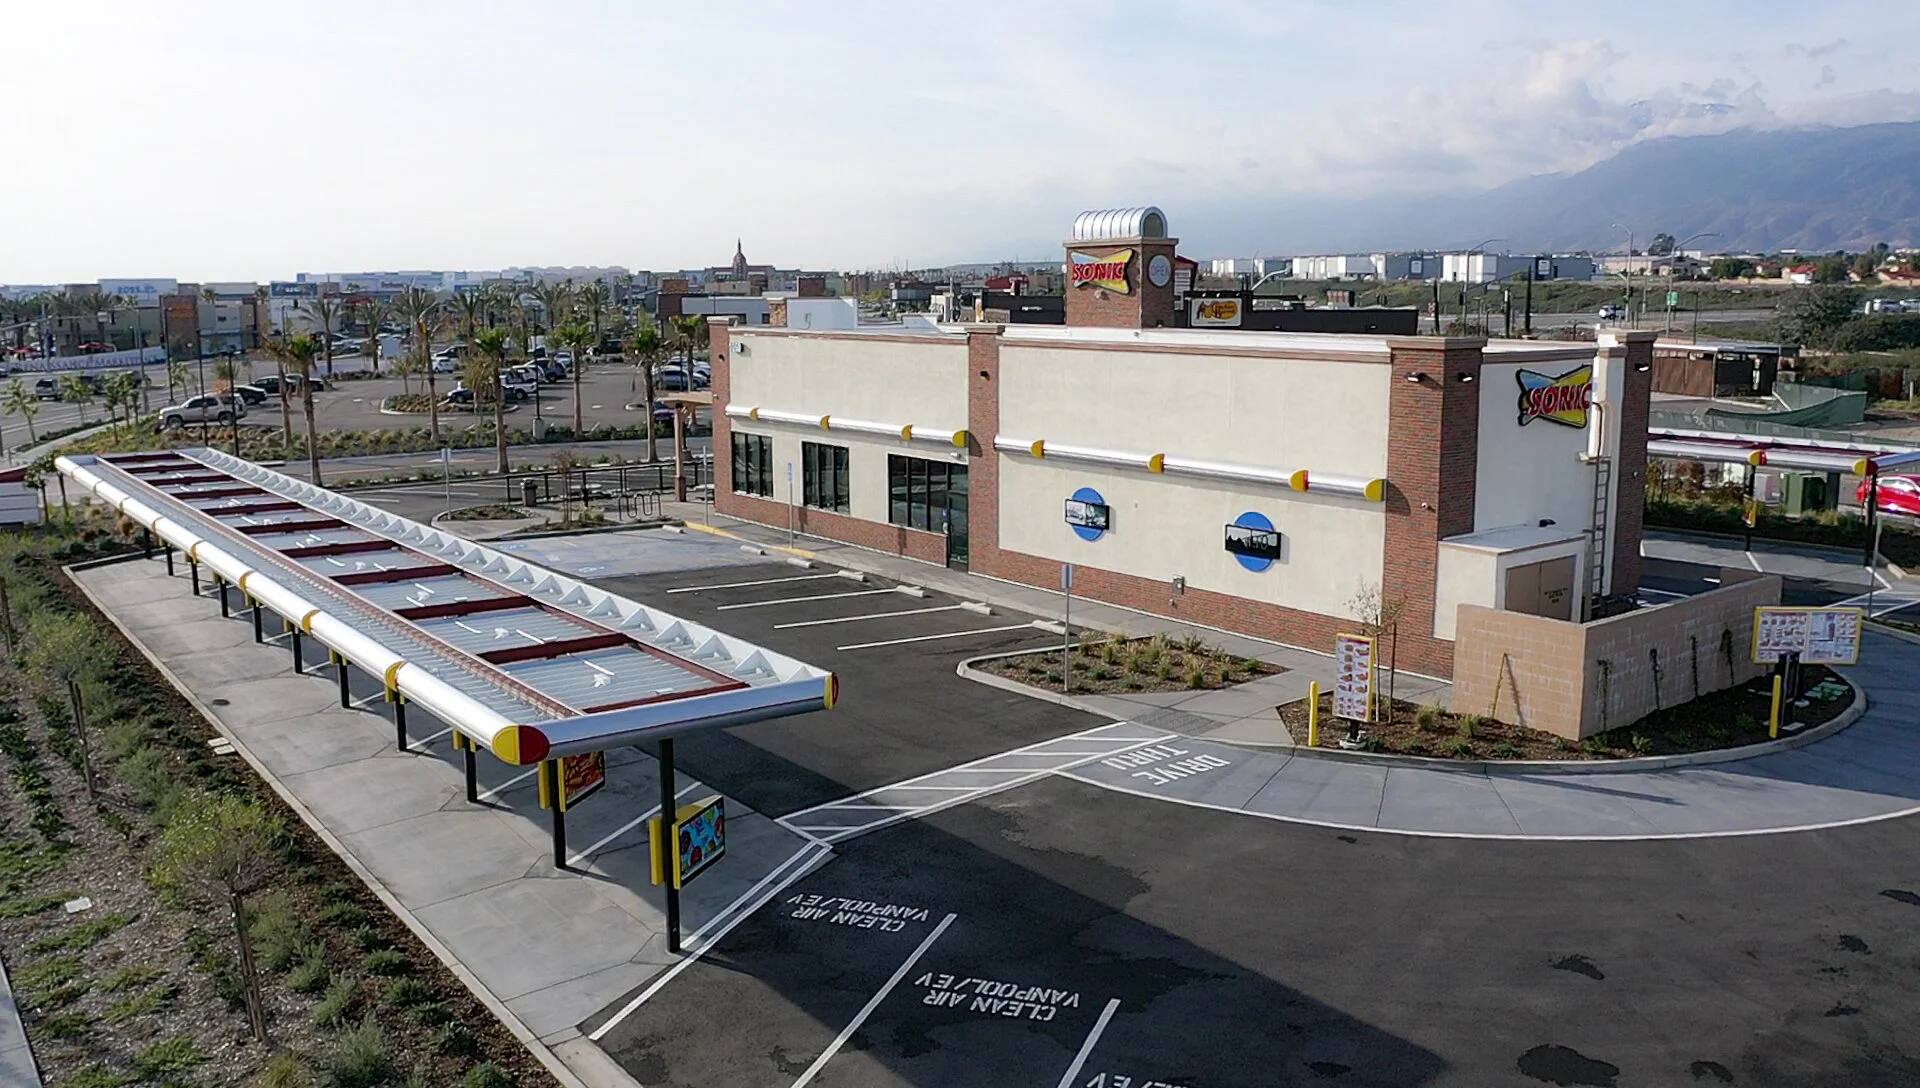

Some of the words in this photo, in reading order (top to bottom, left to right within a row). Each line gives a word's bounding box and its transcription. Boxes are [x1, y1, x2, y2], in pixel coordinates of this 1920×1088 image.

[1072, 262, 1127, 281] SONIC
[1526, 382, 1592, 415] SONIC
[1101, 744, 1189, 770] THRU
[1131, 754, 1231, 786] DRIVE
[787, 894, 929, 921] VANPOOL/EV
[791, 906, 830, 920] AIR
[830, 911, 905, 932] CLEAN
[914, 972, 1080, 1008] VANPOOL/EV
[923, 990, 967, 1007] AIR
[969, 996, 1056, 1021] CLEAN
